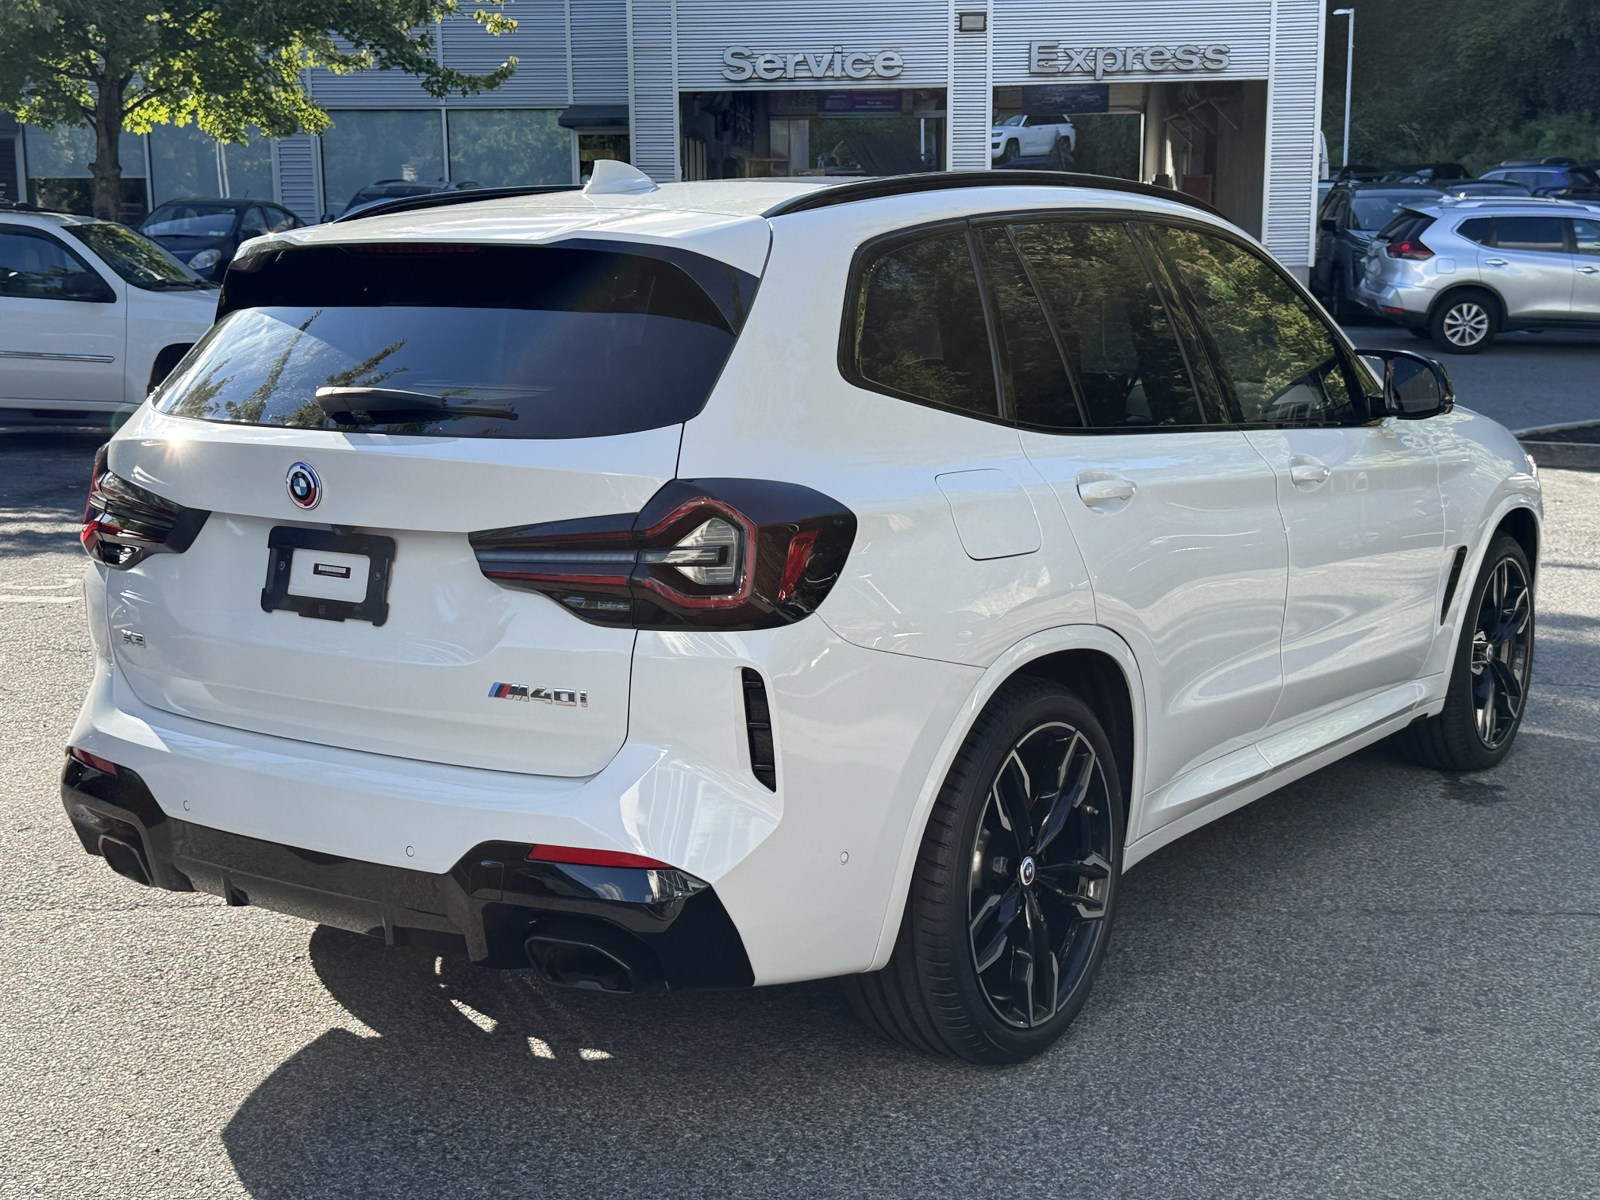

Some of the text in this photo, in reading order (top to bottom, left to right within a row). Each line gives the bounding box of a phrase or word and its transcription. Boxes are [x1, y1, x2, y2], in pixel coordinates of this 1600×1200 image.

[721, 45, 904, 81] Service
[1029, 40, 1231, 81] Express
[488, 681, 588, 708] M40i
